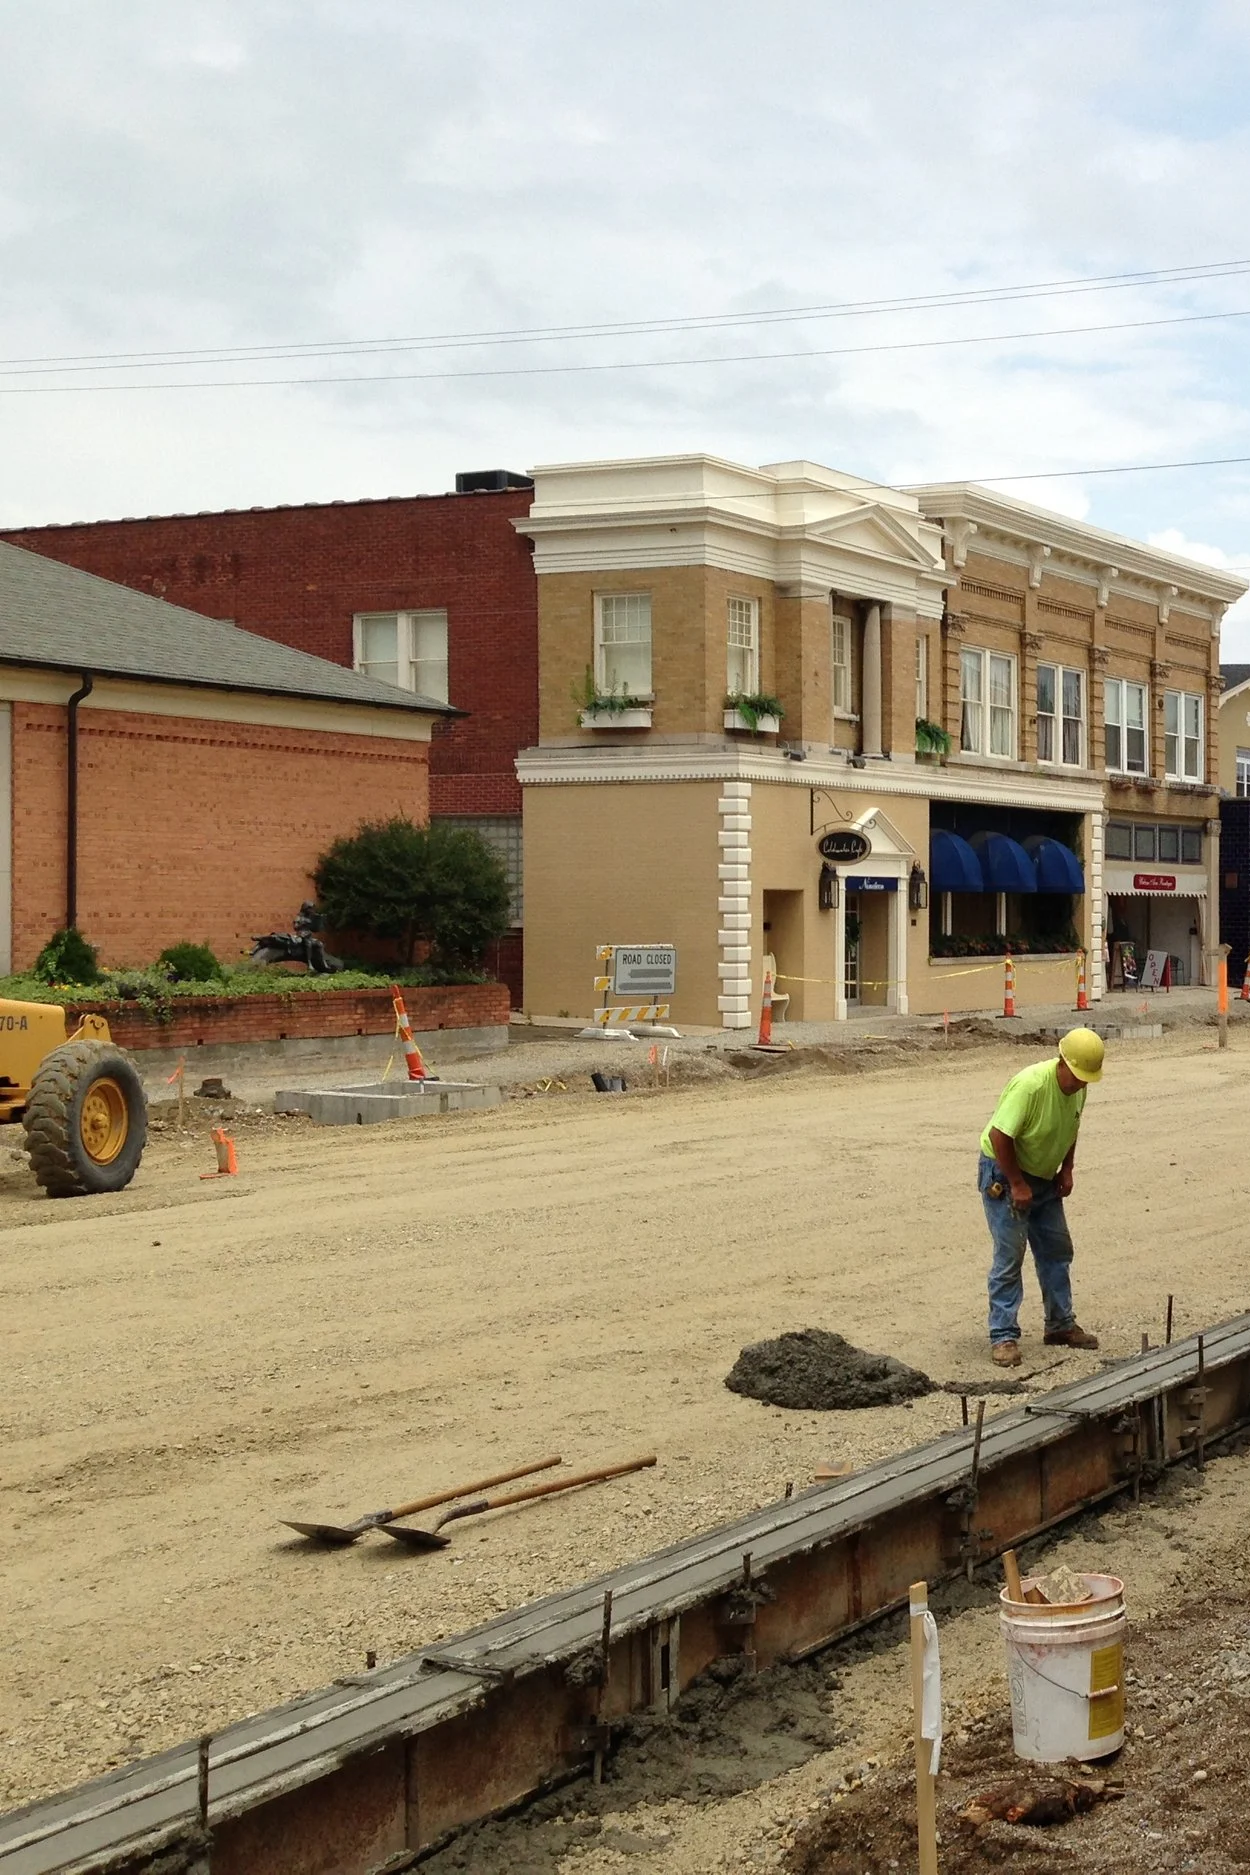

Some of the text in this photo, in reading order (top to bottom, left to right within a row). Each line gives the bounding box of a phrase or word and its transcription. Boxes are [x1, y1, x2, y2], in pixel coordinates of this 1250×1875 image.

[622, 954, 672, 965] ROAD CLOSED
[1148, 953, 1161, 986] OPEN
